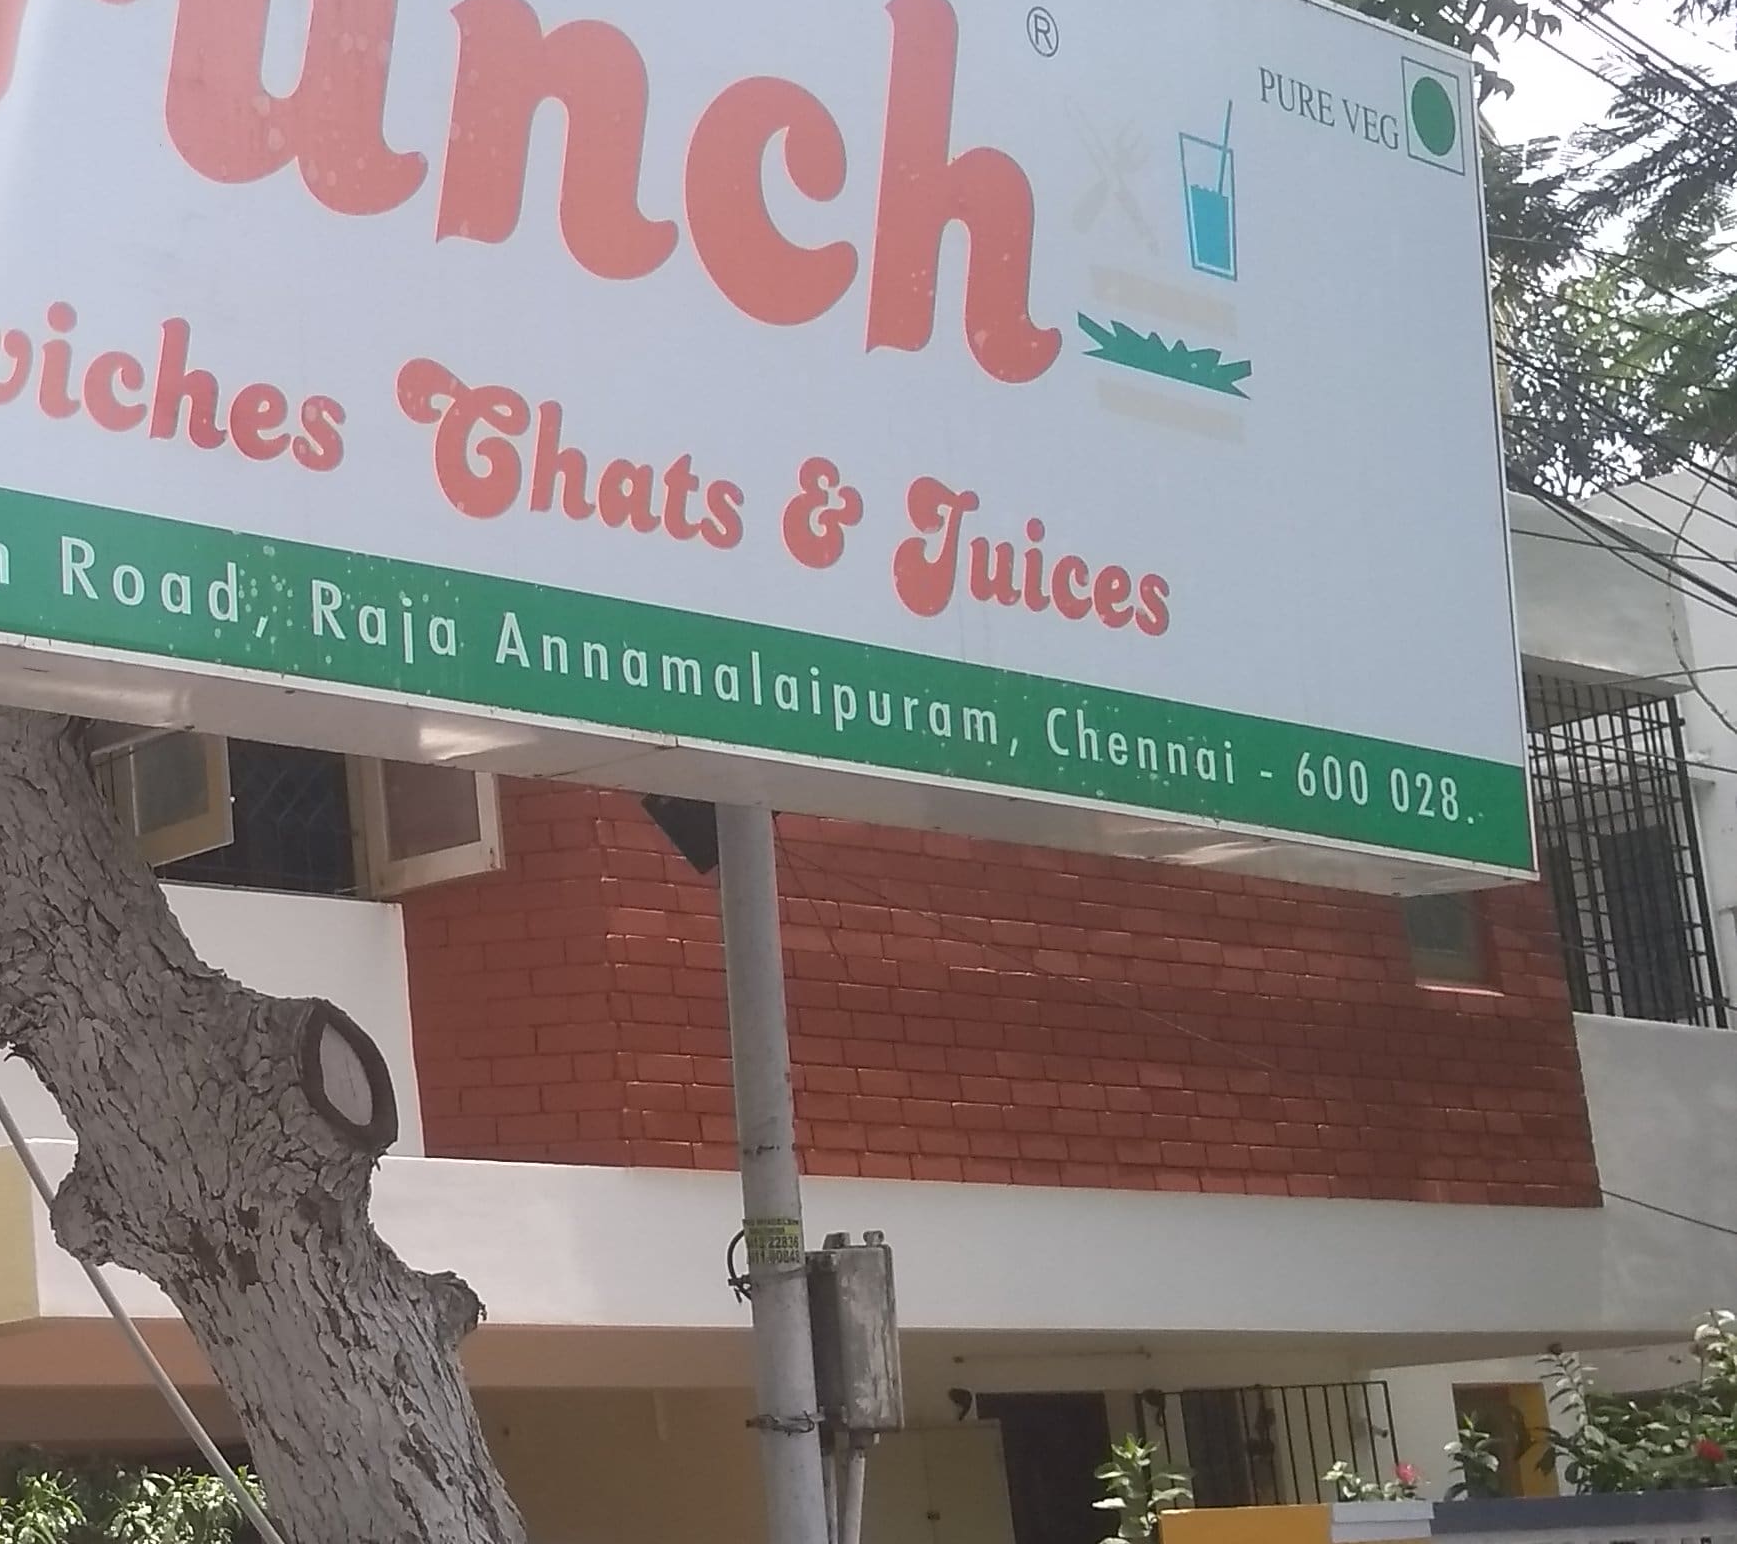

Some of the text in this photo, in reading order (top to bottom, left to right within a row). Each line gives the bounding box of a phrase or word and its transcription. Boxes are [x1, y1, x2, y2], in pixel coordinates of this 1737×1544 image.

[1258, 66, 1400, 151] PURE VEG
[396, 356, 745, 549] Chats
[783, 456, 864, 569] &
[893, 476, 1170, 637] Juices
[60, 536, 269, 639] Road,
[311, 578, 458, 665] Raja
[495, 610, 1020, 758] Annamalaipuram,
[1046, 707, 1238, 785] Chennai
[1297, 751, 1370, 806] 600
[1389, 771, 1475, 824] 028.
